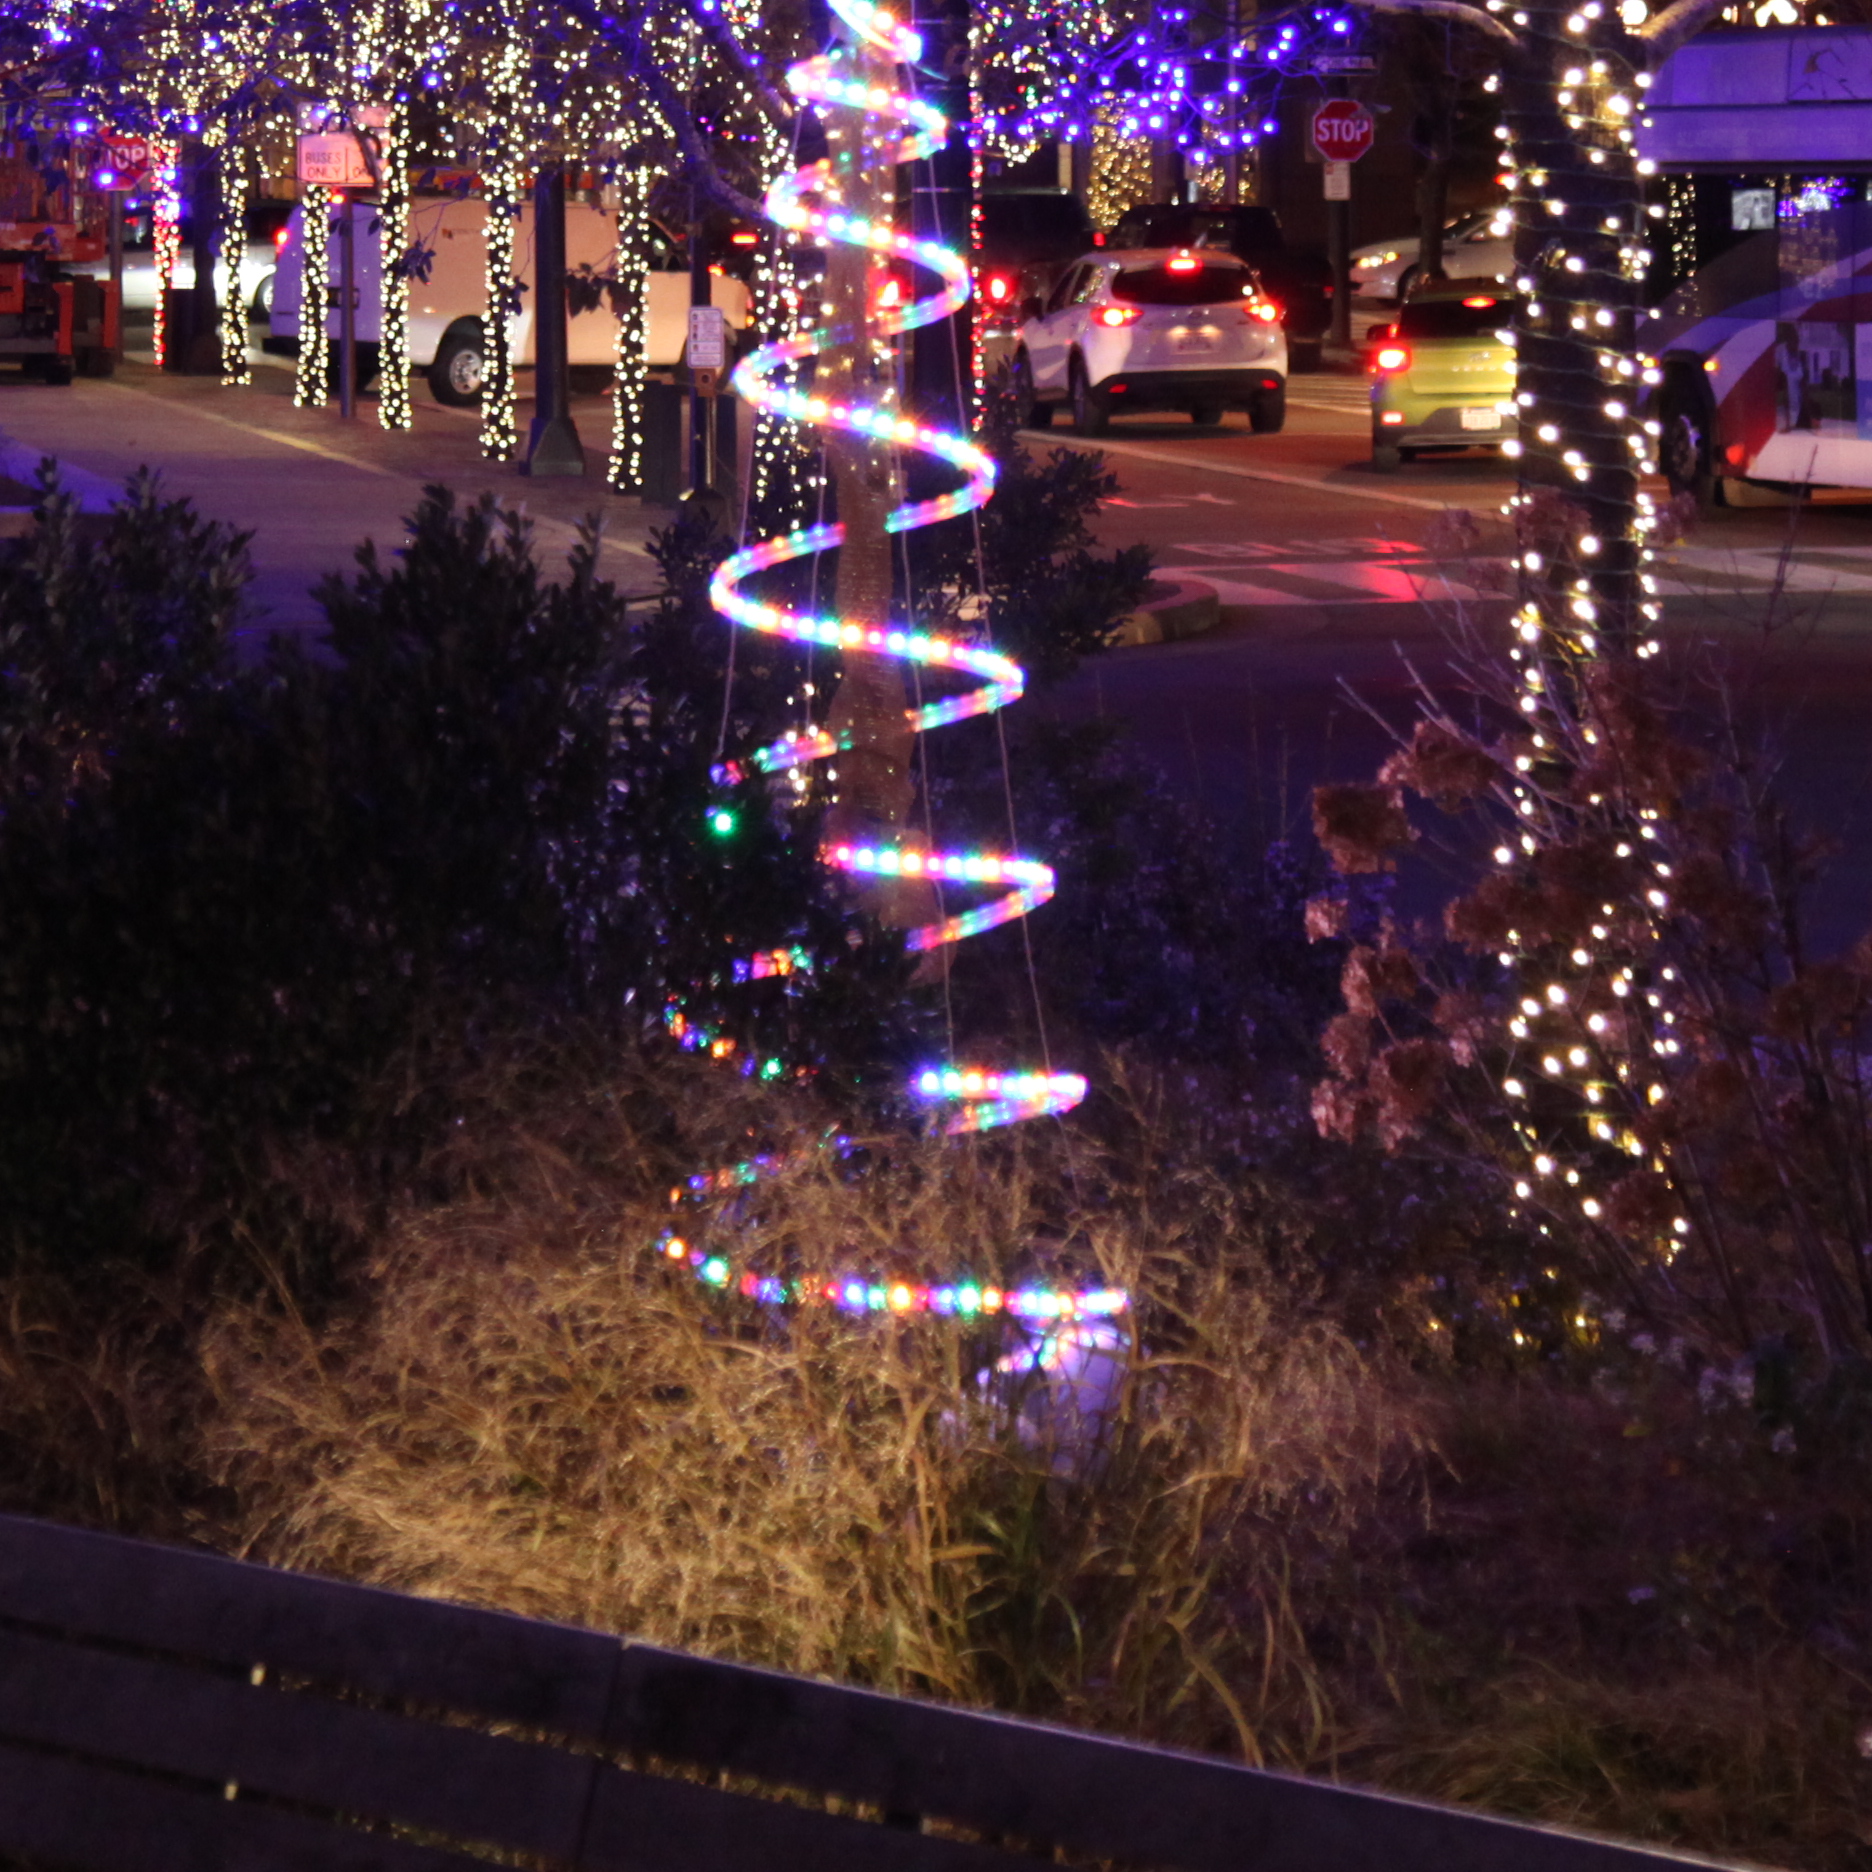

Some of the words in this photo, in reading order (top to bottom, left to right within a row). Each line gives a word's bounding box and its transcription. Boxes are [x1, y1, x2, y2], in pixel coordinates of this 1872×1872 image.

[1318, 119, 1368, 142] STOP
[305, 152, 341, 164] BUSES
[307, 167, 340, 178] ONLY
